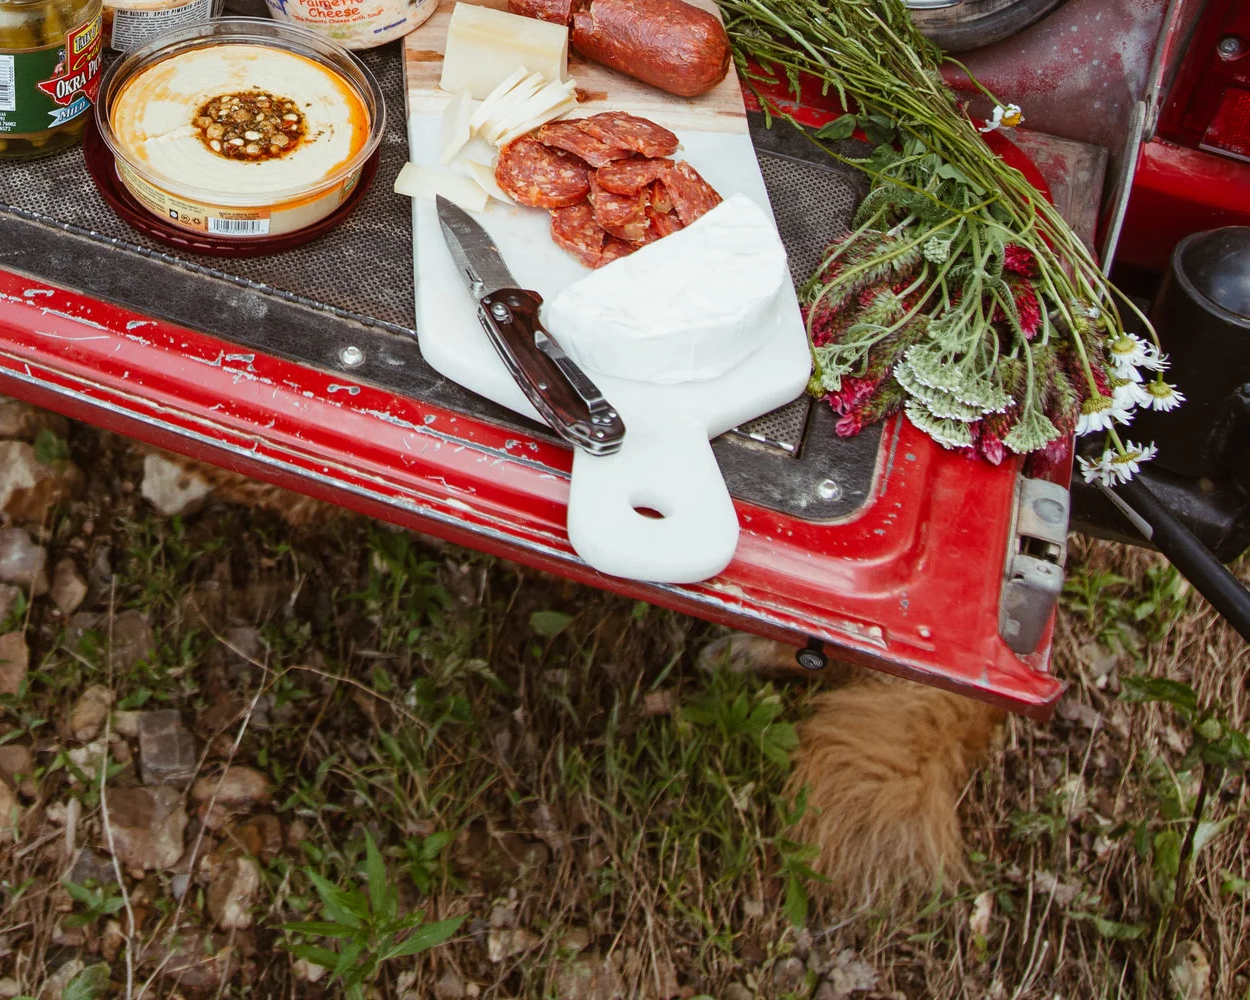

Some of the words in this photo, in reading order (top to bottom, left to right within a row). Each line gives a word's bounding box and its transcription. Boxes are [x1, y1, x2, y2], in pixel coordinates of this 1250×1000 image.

[153, 10, 170, 18] SPICY
[170, 3, 193, 15] PIMENTO
[308, 7, 361, 19] Cheese
[75, 32, 92, 52] TALK
[56, 73, 87, 99] OKRA
[58, 100, 86, 122] MILD
